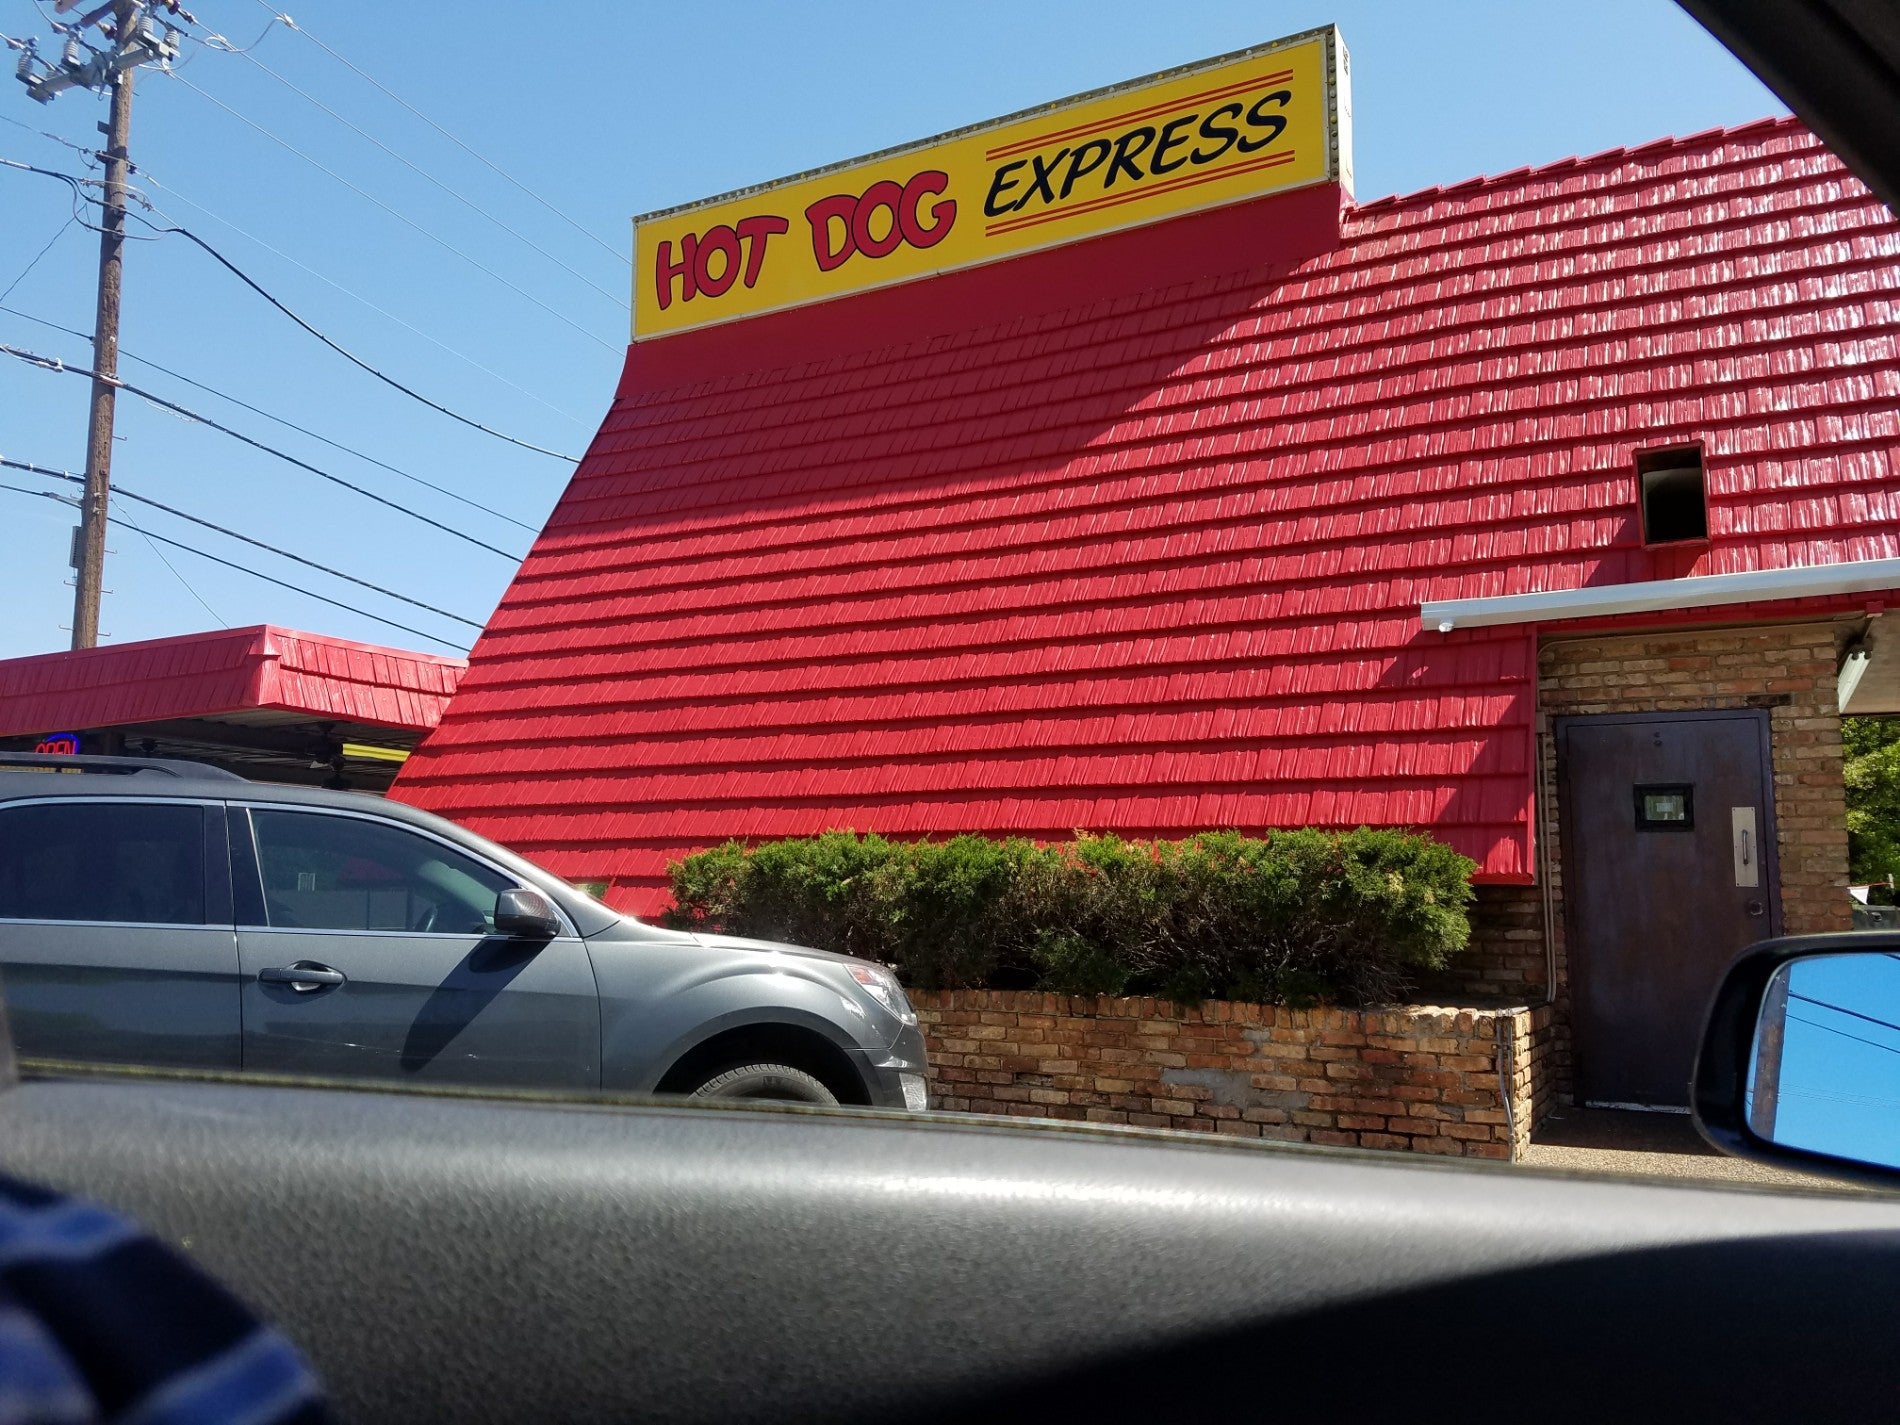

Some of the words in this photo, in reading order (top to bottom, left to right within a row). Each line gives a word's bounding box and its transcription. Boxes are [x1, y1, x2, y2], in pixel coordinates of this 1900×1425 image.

[656, 215, 789, 311] HOT
[804, 170, 957, 272] DOG
[983, 90, 1292, 218] EXPRESS
